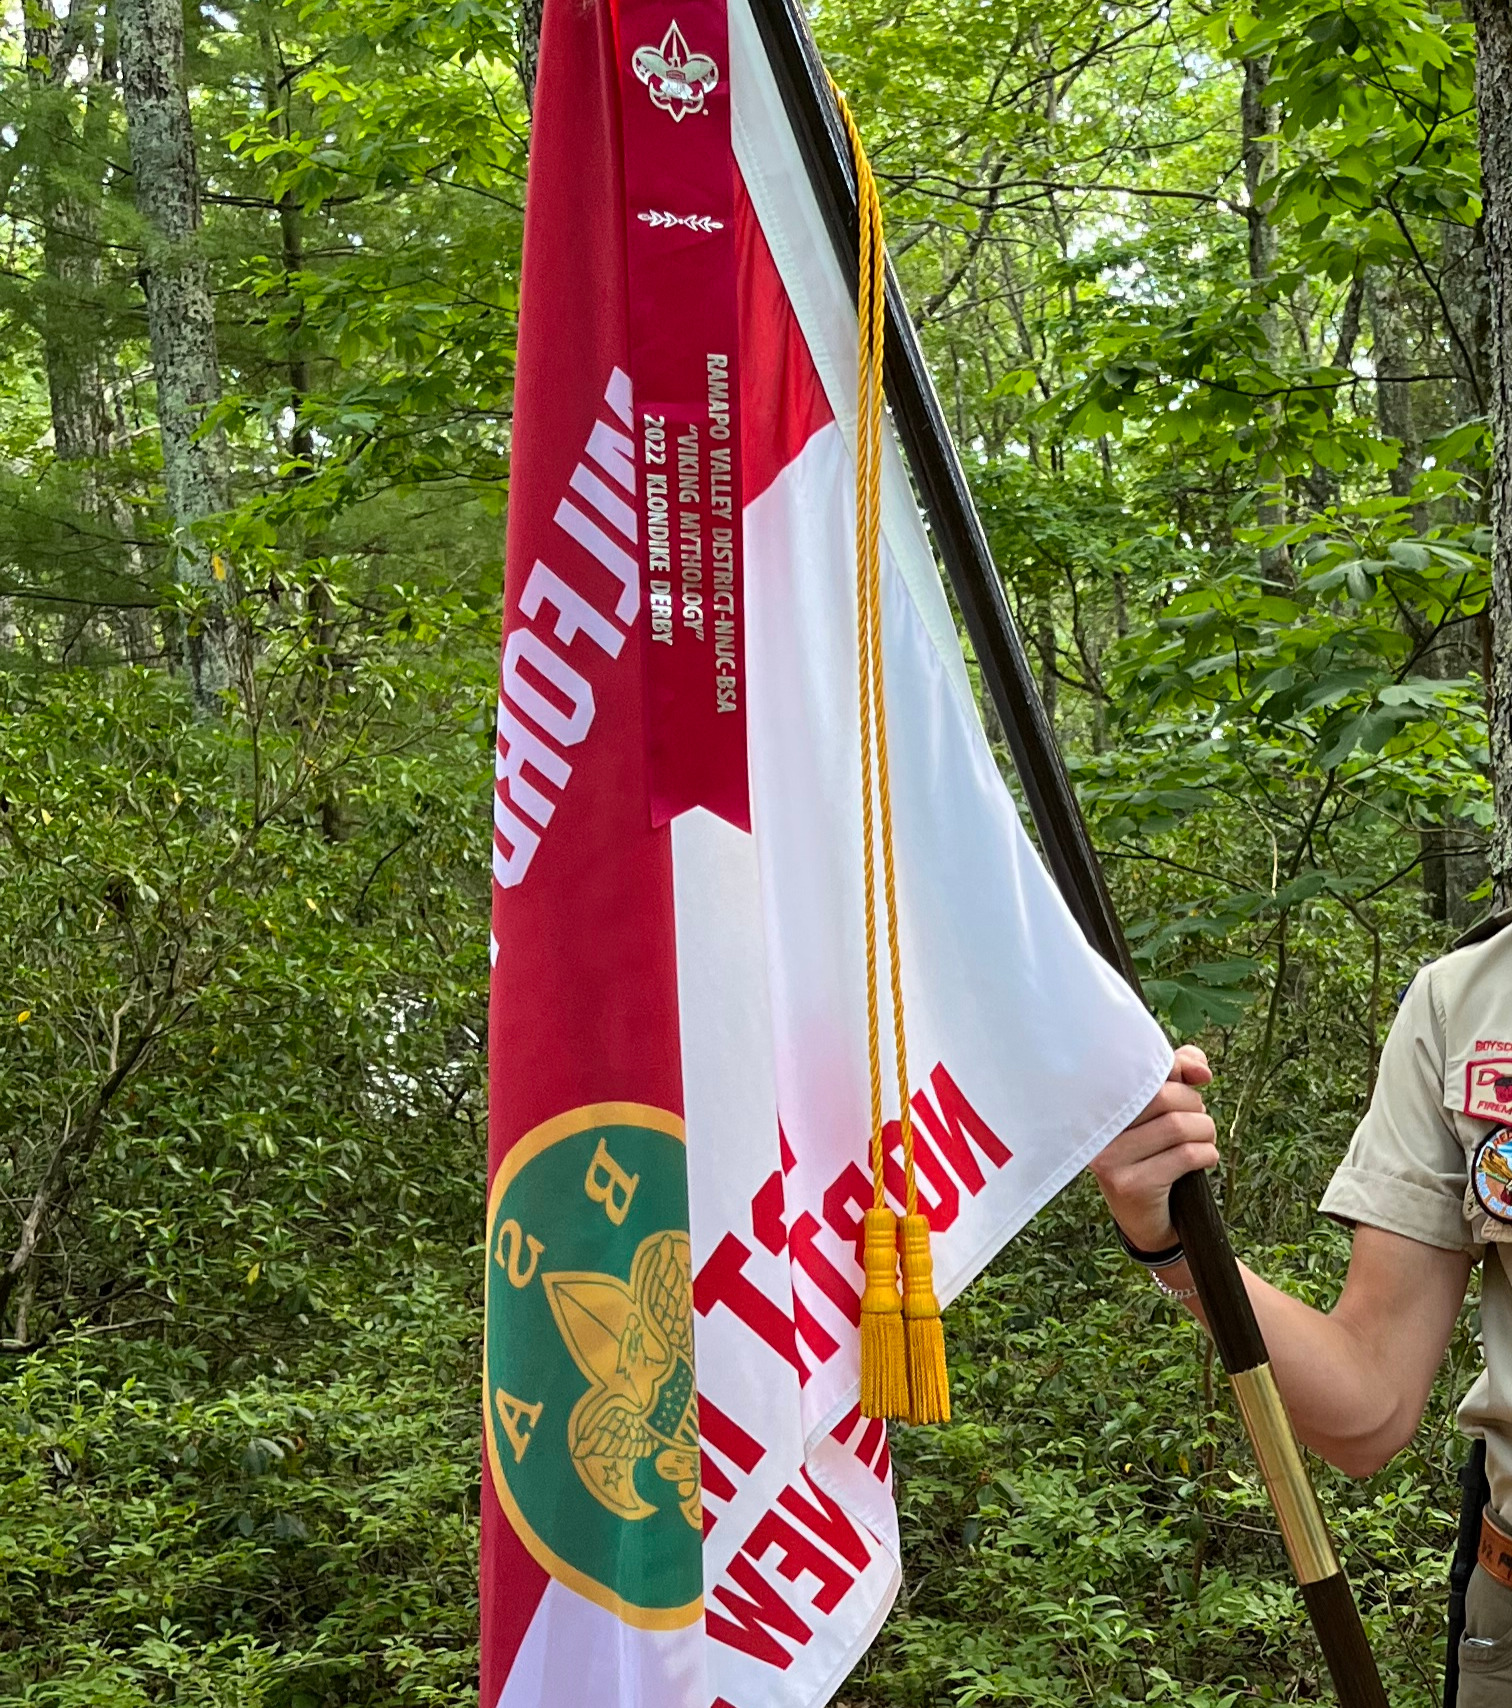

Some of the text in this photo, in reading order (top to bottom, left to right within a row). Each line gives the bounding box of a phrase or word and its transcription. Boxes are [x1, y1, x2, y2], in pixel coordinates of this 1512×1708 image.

[706, 352, 731, 440] RAMAPO
[709, 448, 733, 521] VALLEY
[643, 413, 673, 646] 2022 KLONDIKE DERBY
